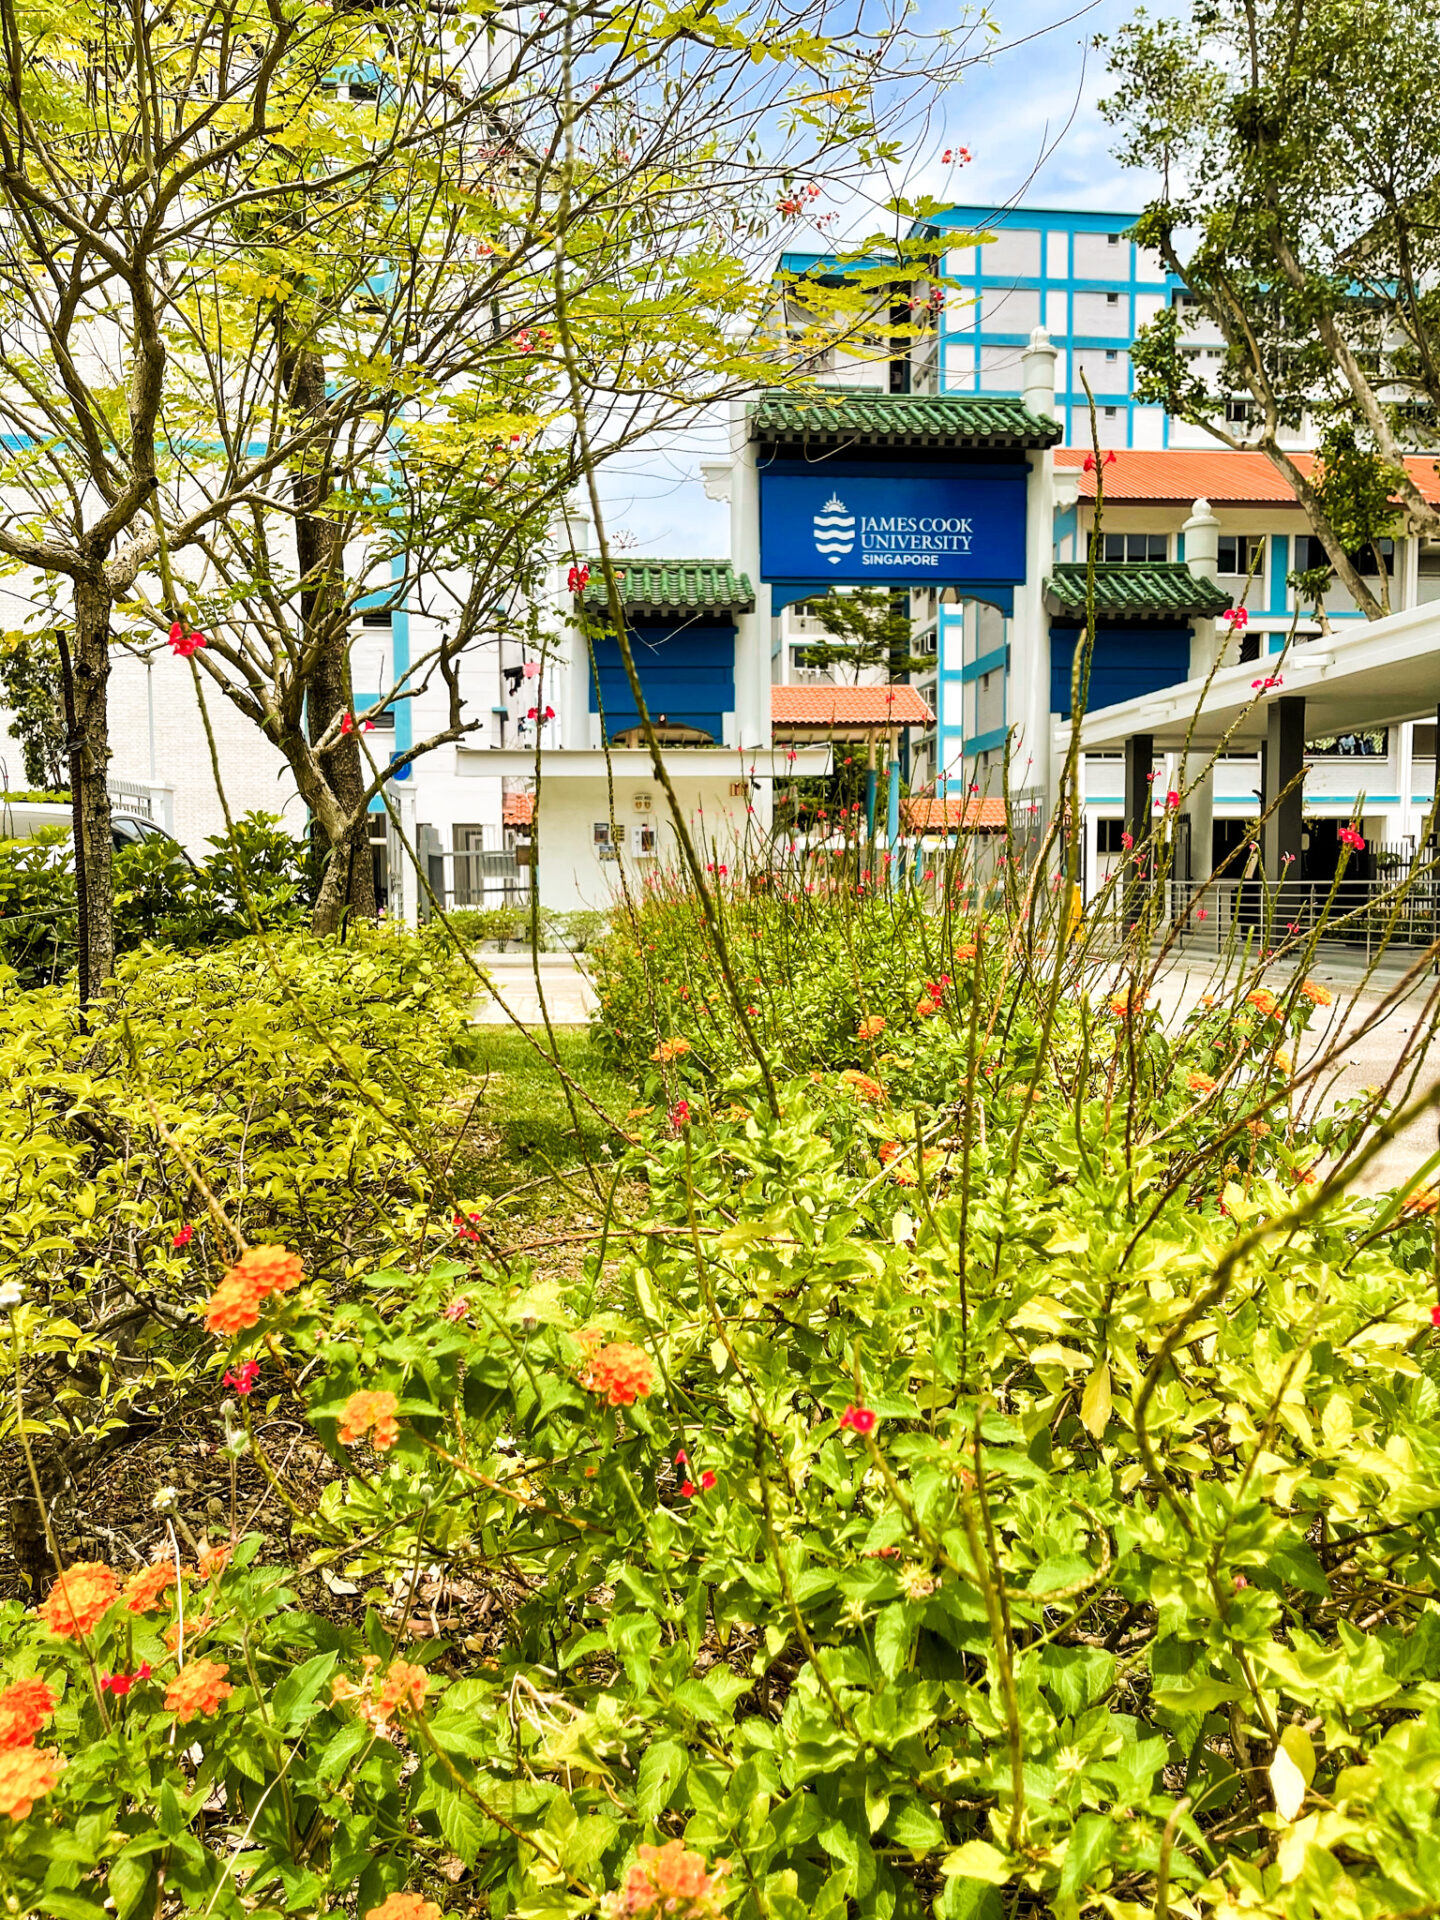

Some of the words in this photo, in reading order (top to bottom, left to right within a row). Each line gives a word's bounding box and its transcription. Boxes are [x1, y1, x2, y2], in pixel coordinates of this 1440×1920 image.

[860, 517, 917, 533] JAMES
[919, 518, 973, 533] COOK
[860, 534, 972, 550] UNIVERSITY
[862, 554, 939, 565] SINGAPORE
